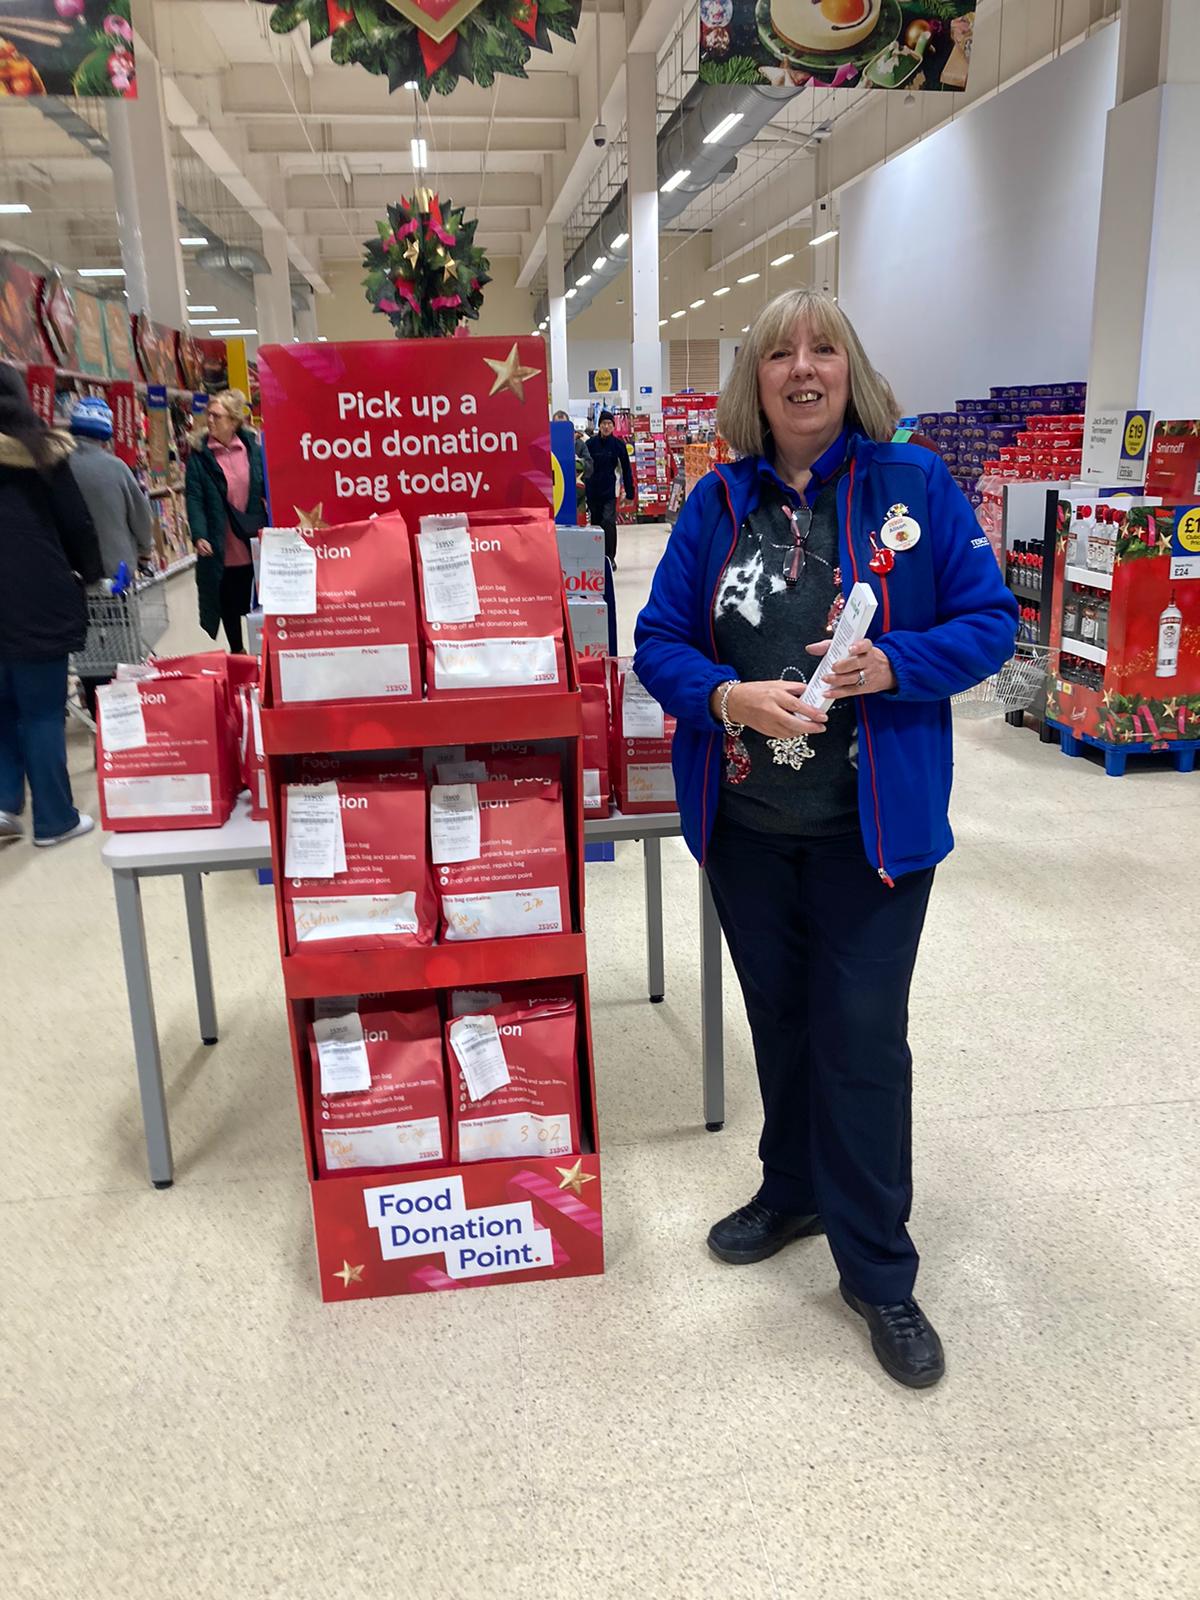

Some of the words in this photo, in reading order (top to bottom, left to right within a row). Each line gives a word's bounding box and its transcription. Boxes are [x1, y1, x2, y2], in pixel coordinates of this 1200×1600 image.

[337, 390, 402, 420] Pick
[411, 395, 450, 423] up
[459, 394, 477, 415] a
[1128, 423, 1144, 439] £19
[300, 430, 372, 461] food
[382, 426, 518, 458] donation
[1156, 442, 1185, 454] Smirnoff
[335, 470, 391, 503] bag
[397, 466, 490, 499] today.
[470, 538, 501, 553] tion
[970, 536, 989, 546] TESCO
[315, 544, 351, 560] tion
[1174, 568, 1189, 577] £24
[560, 570, 605, 592] oke
[347, 602, 359, 612] bag
[360, 601, 373, 609] and
[138, 691, 167, 705] tion
[364, 1029, 389, 1042] ion
[379, 1188, 452, 1217] Food
[391, 1215, 522, 1247] Donation
[459, 1243, 542, 1270] Point.
